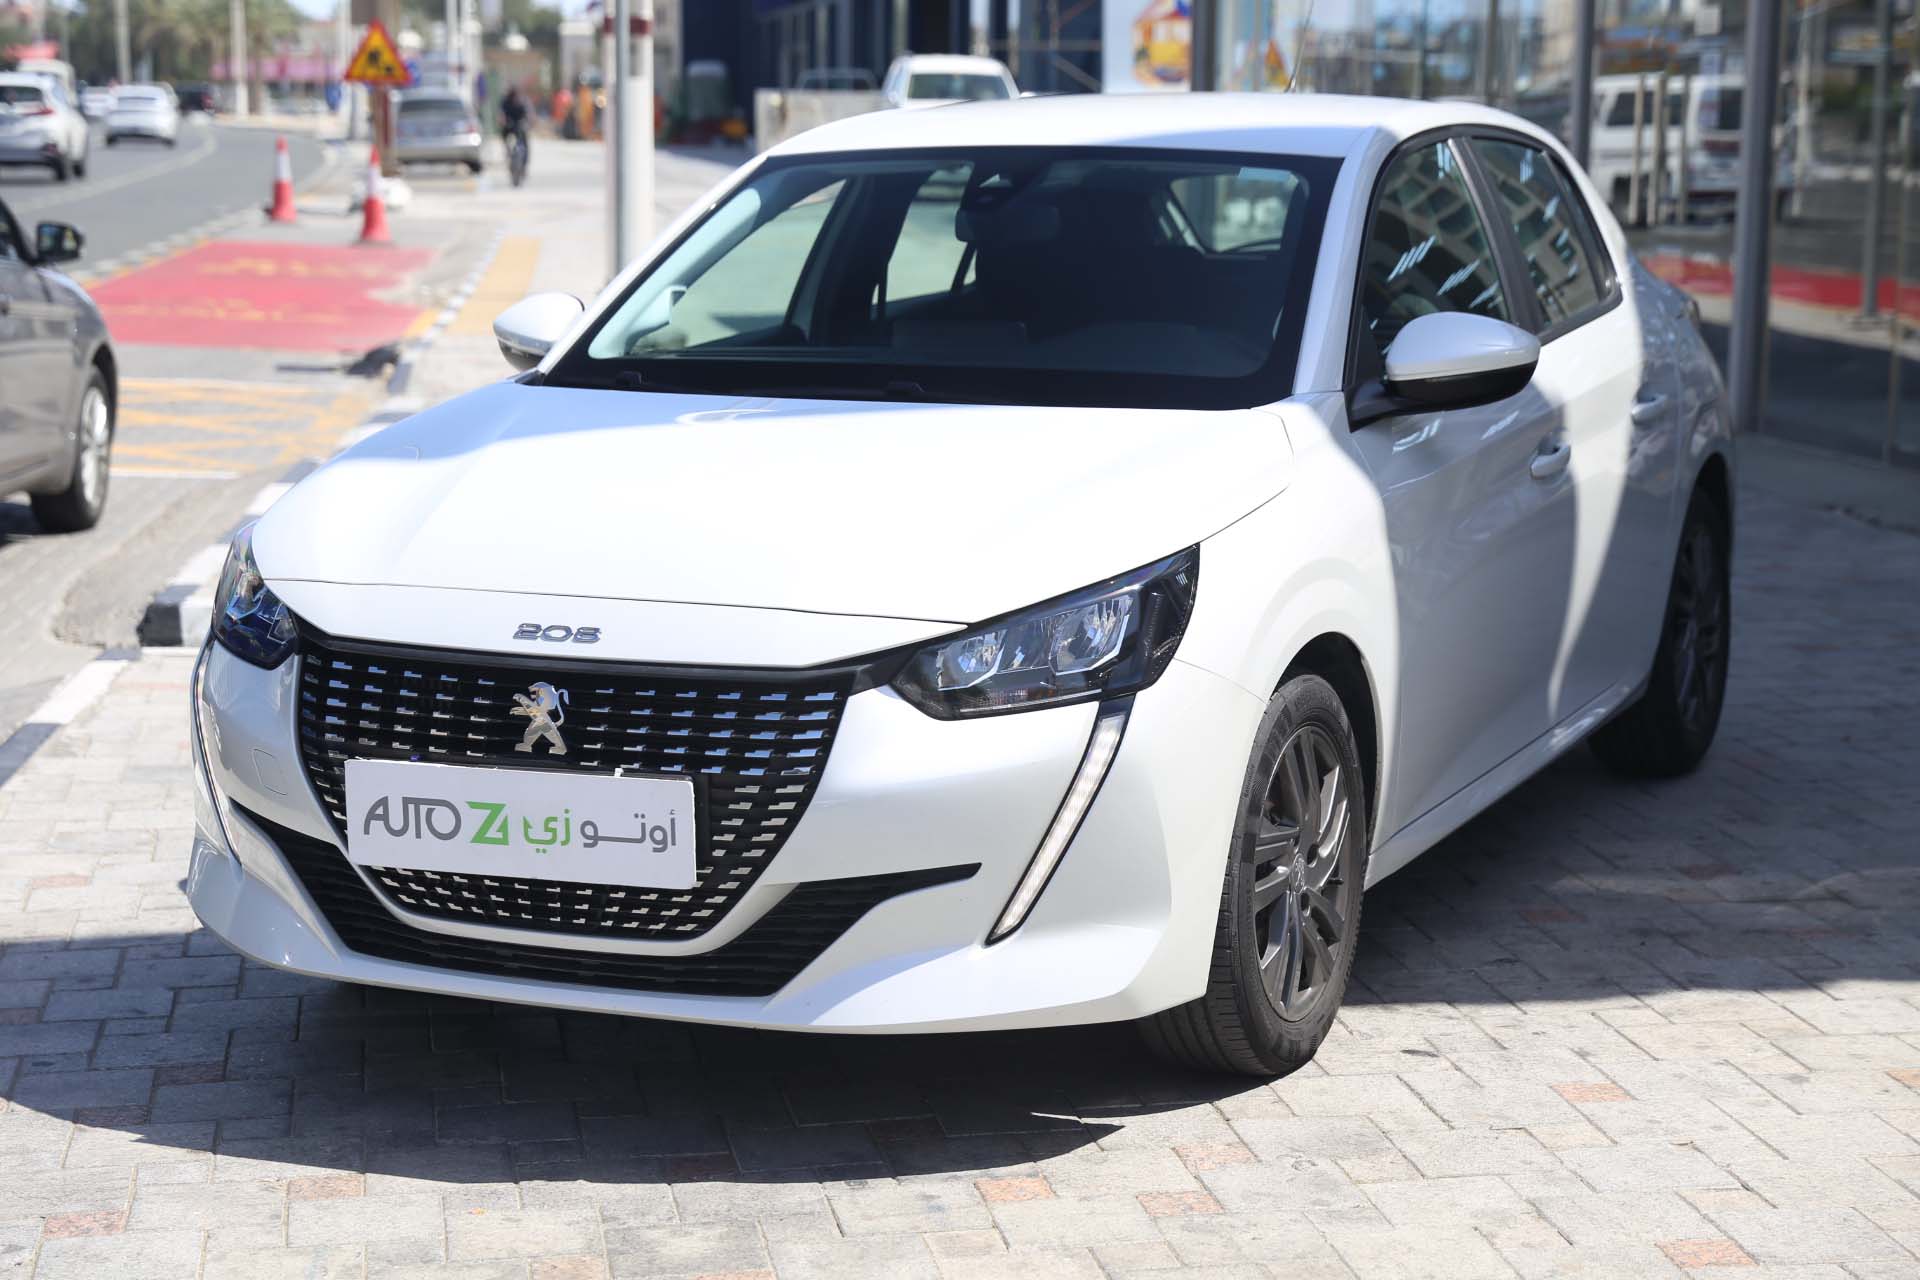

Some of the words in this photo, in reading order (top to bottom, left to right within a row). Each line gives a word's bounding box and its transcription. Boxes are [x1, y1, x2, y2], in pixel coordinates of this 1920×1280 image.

[513, 623, 601, 643] 208
[363, 796, 462, 841] AUTO
[465, 801, 510, 846] Z
